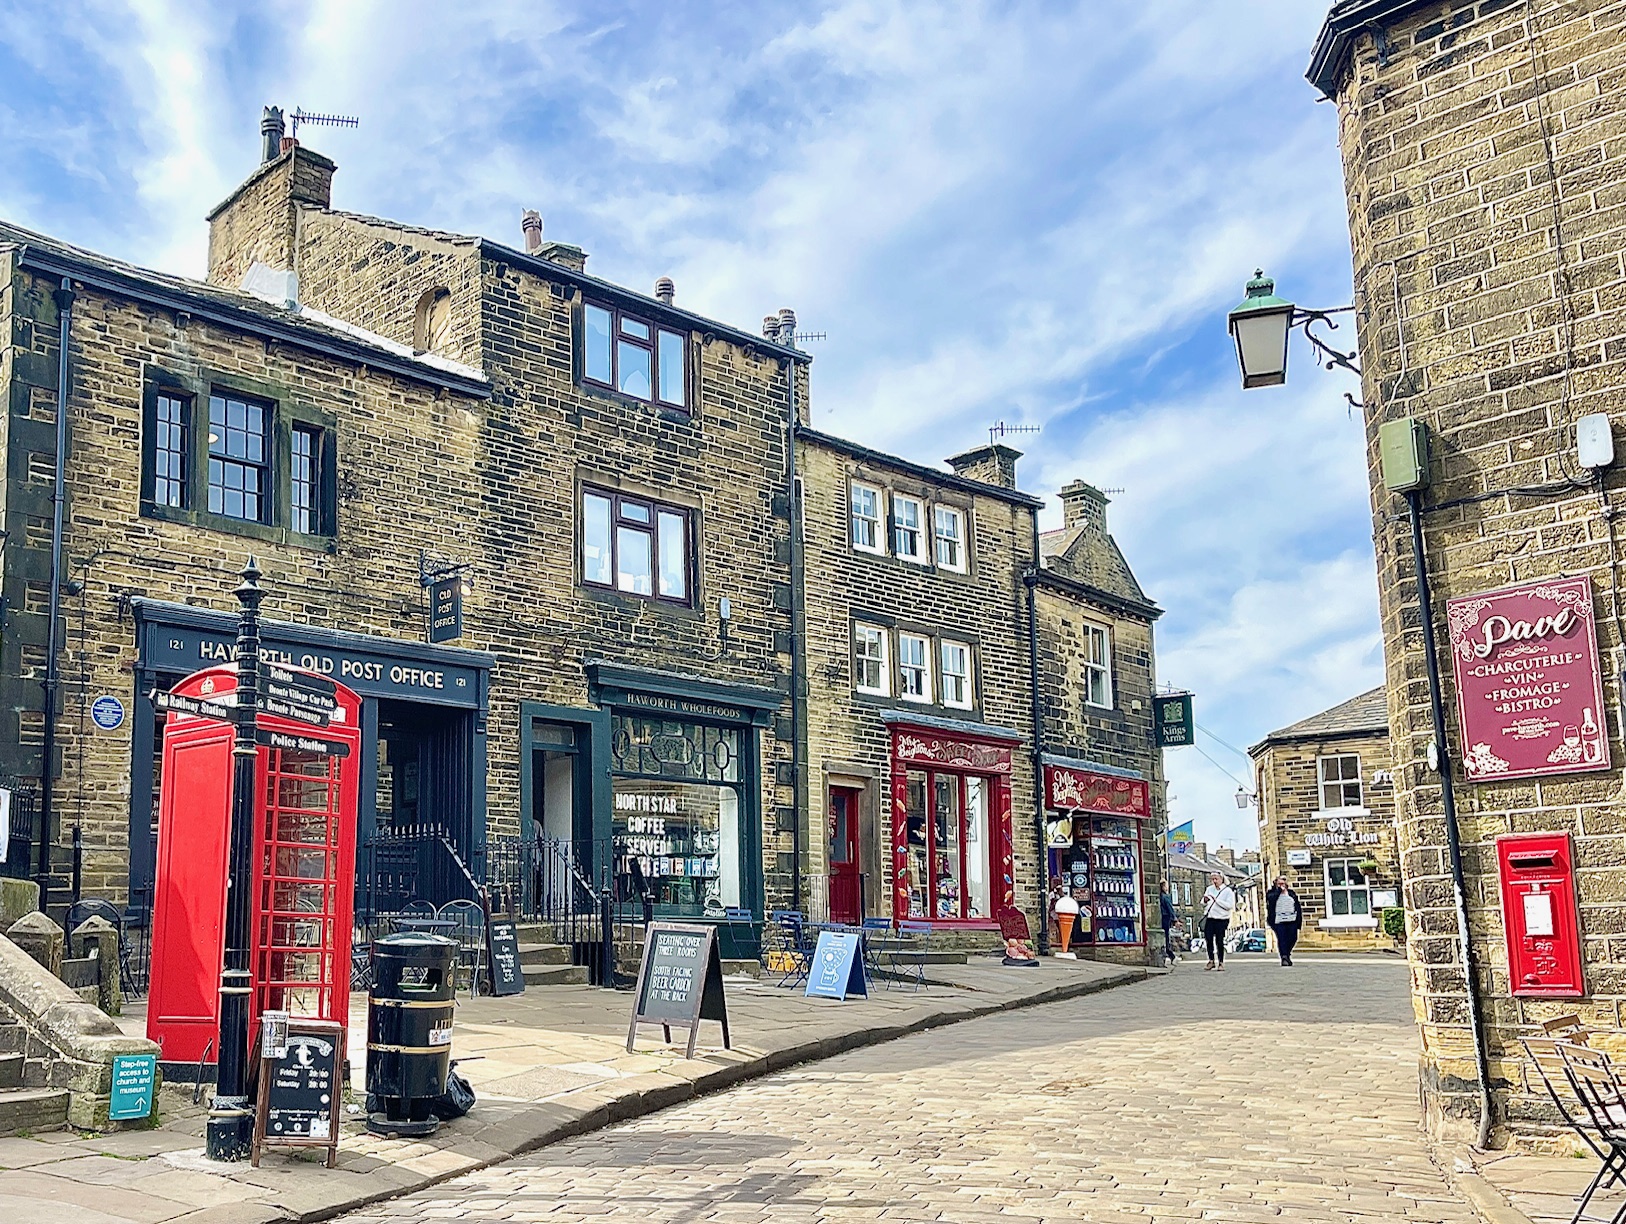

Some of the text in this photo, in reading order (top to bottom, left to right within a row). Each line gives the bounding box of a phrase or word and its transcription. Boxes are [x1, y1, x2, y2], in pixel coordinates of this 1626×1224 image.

[439, 589, 451, 600] OLD
[438, 602, 453, 614] POST
[434, 615, 456, 629] OFFICE
[1471, 607, 1577, 659] Pavé
[169, 640, 184, 650] 121
[200, 641, 292, 664] HAWRTH
[301, 654, 334, 674] OLD
[341, 660, 383, 681] POST
[390, 666, 444, 689] OFFICE
[1474, 653, 1573, 677] CHARCUTERIE
[270, 667, 294, 682] Toilets
[1510, 672, 1538, 686] VIN
[1492, 682, 1561, 702] FROMAGE
[169, 694, 227, 717] Railway Station
[309, 694, 321, 704] Car
[321, 696, 334, 708] Park
[627, 693, 740, 718] HAWORTH WHOLEFOODS
[1502, 695, 1553, 714] BISTRO
[1163, 726, 1186, 736] Kings
[271, 733, 327, 752] Police Station
[1164, 735, 1186, 743] Arms
[628, 816, 665, 835] COFFEE
[1327, 818, 1353, 832] Old
[1304, 831, 1378, 846] White Lion
[627, 838, 667, 856] SERVED
[686, 937, 701, 948] OVER
[677, 947, 697, 958] ROOMS
[654, 966, 671, 976] SOUTH
[652, 976, 668, 989] BEER
[650, 990, 687, 1002] AT THE BACK
[120, 1060, 149, 1069] Step-free
[280, 1068, 299, 1077] Friday
[116, 1076, 151, 1086] church and
[276, 1079, 300, 1089] Saturday
